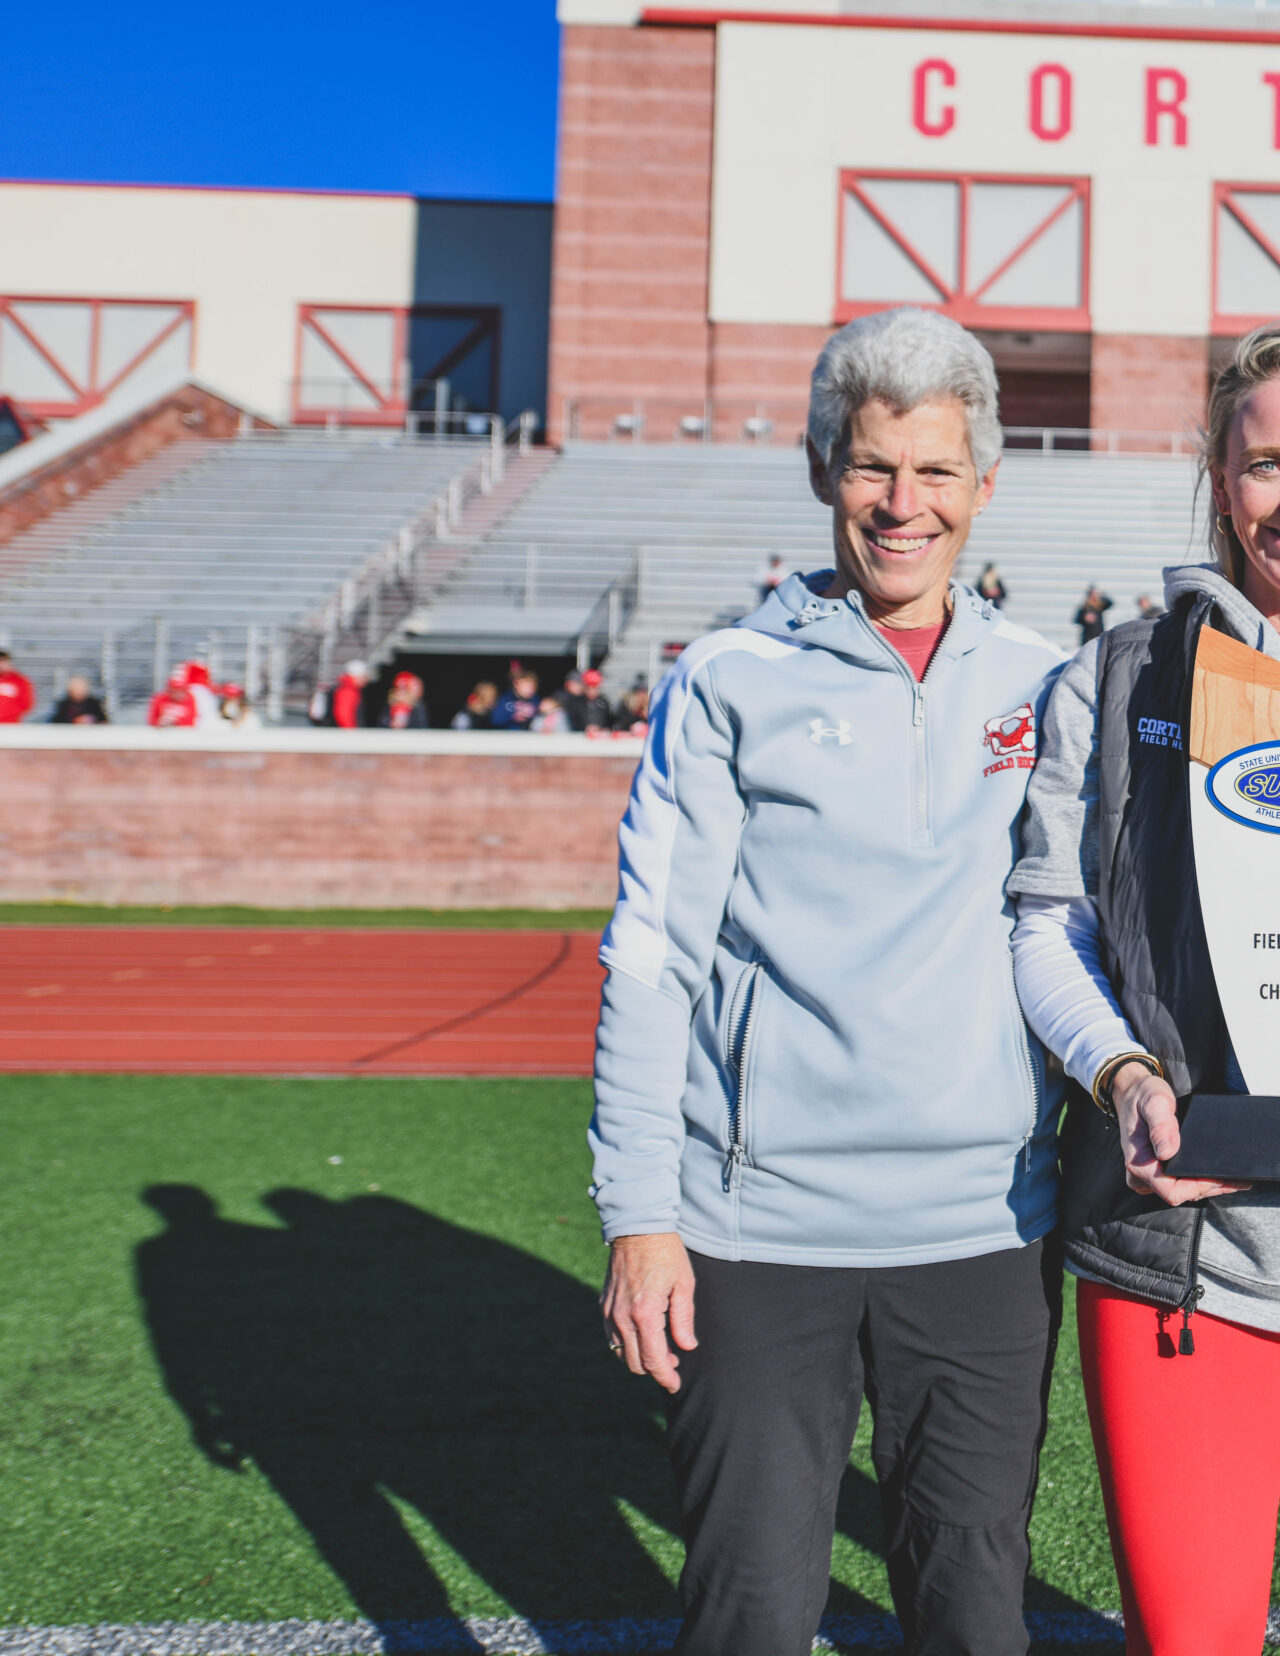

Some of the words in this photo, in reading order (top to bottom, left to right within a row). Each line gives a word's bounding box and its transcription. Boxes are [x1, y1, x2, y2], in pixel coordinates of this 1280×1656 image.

[1140, 733, 1168, 746] FIELD
[983, 757, 1015, 778] FIELD
[1239, 757, 1264, 770] STATE
